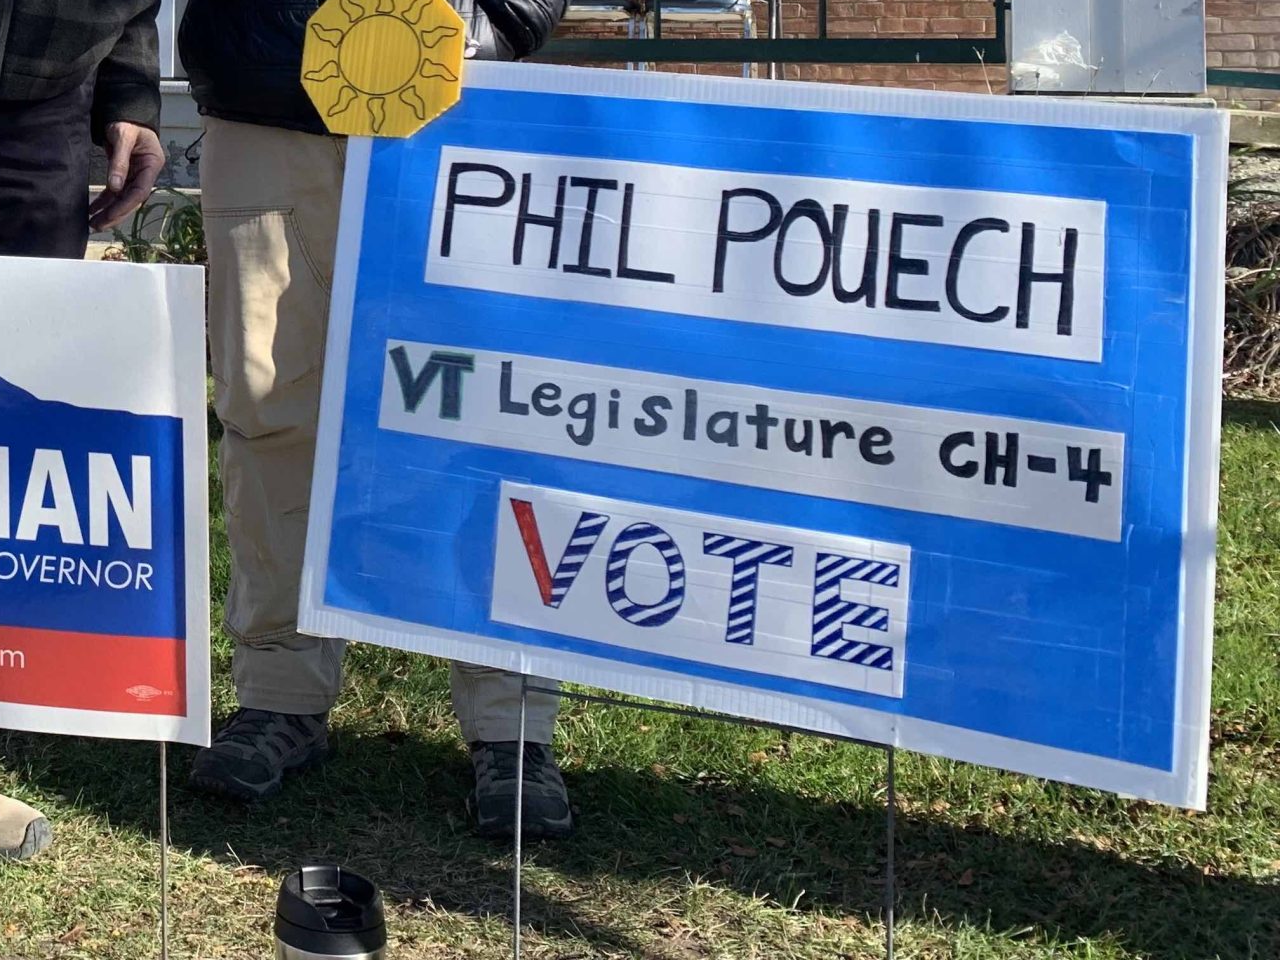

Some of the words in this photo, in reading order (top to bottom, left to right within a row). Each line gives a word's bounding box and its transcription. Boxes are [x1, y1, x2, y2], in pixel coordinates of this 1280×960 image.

[440, 162, 676, 284] PHIL
[712, 187, 1078, 336] POUECH
[388, 345, 475, 420] VT
[499, 360, 896, 466] Legislature
[938, 430, 1113, 504] CH-4
[509, 497, 901, 671] VOTE
